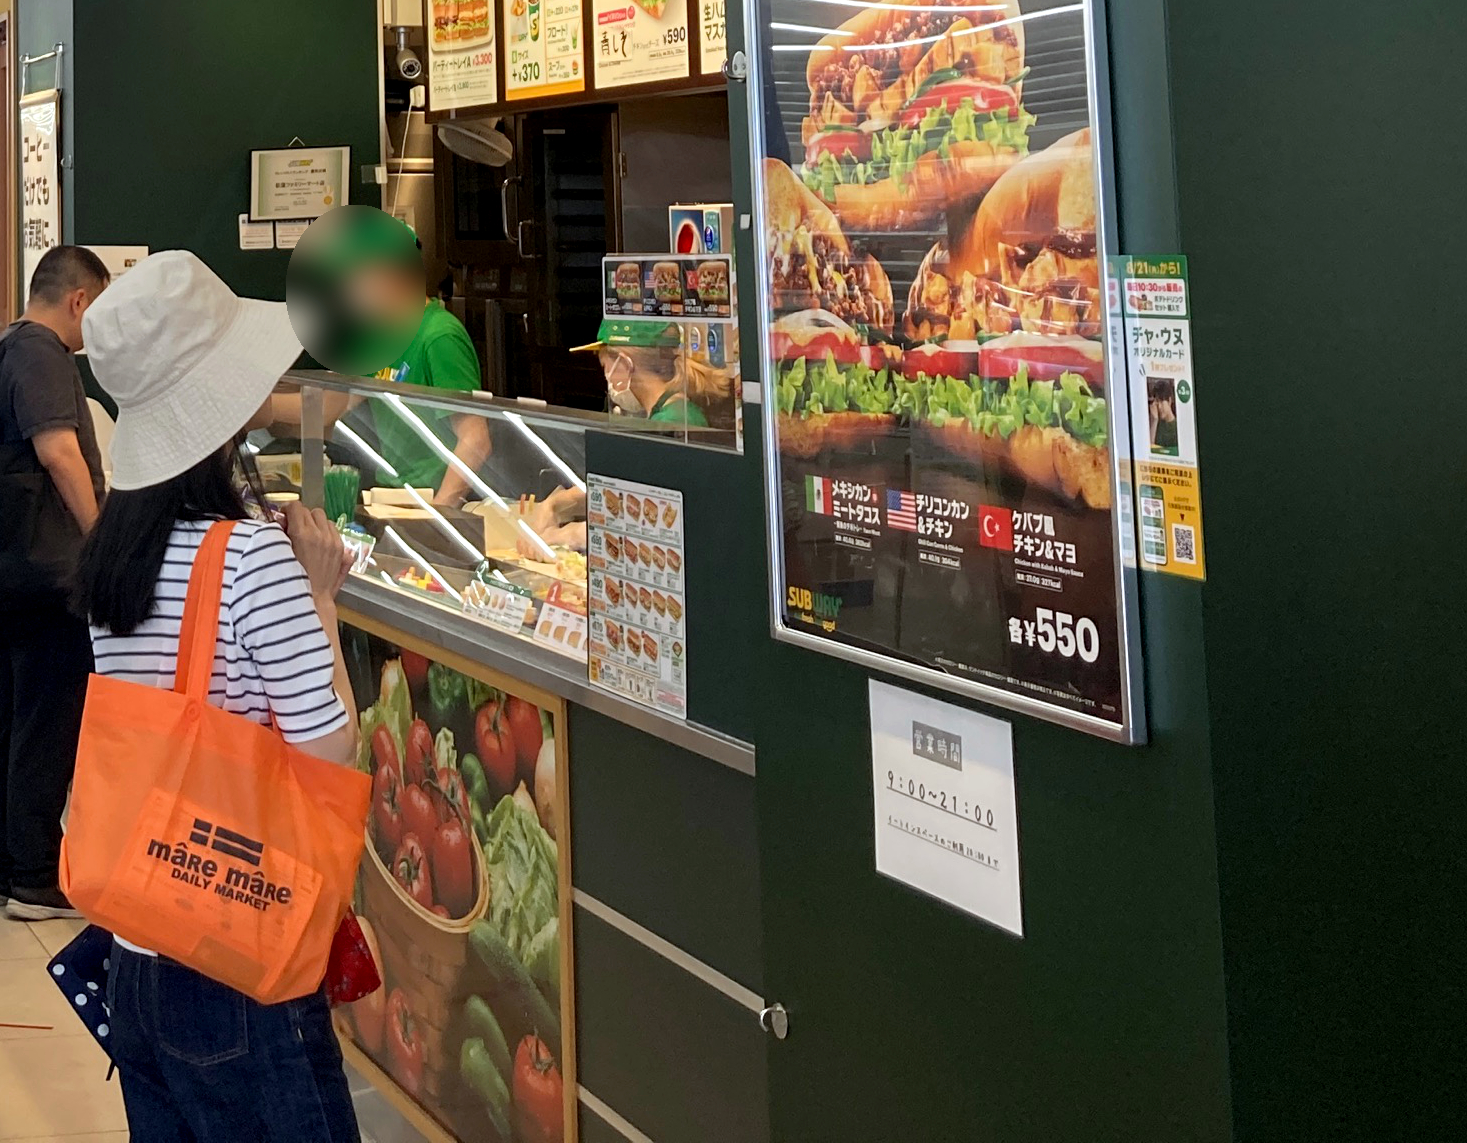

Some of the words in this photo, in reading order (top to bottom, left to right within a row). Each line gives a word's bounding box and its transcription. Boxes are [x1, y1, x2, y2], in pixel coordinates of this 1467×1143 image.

[663, 26, 686, 45] ¥590
[512, 61, 540, 82] +¥370
[24, 134, 50, 163] コーヒー
[1132, 327, 1184, 346] チャ・ウヌ
[1133, 347, 1184, 359] オリジナルカード
[832, 479, 871, 503] メキシカン
[833, 500, 881, 526] ミートタコス
[916, 494, 970, 520] チリコンカン
[918, 516, 953, 539] &チキン
[1013, 534, 1077, 564] チキン&マヨ
[787, 586, 843, 617] SUBWAY
[1008, 607, 1100, 663] 各¥550
[914, 729, 960, 764] 営業時間
[171, 867, 212, 890] DAILY
[214, 883, 271, 912] MARKET
